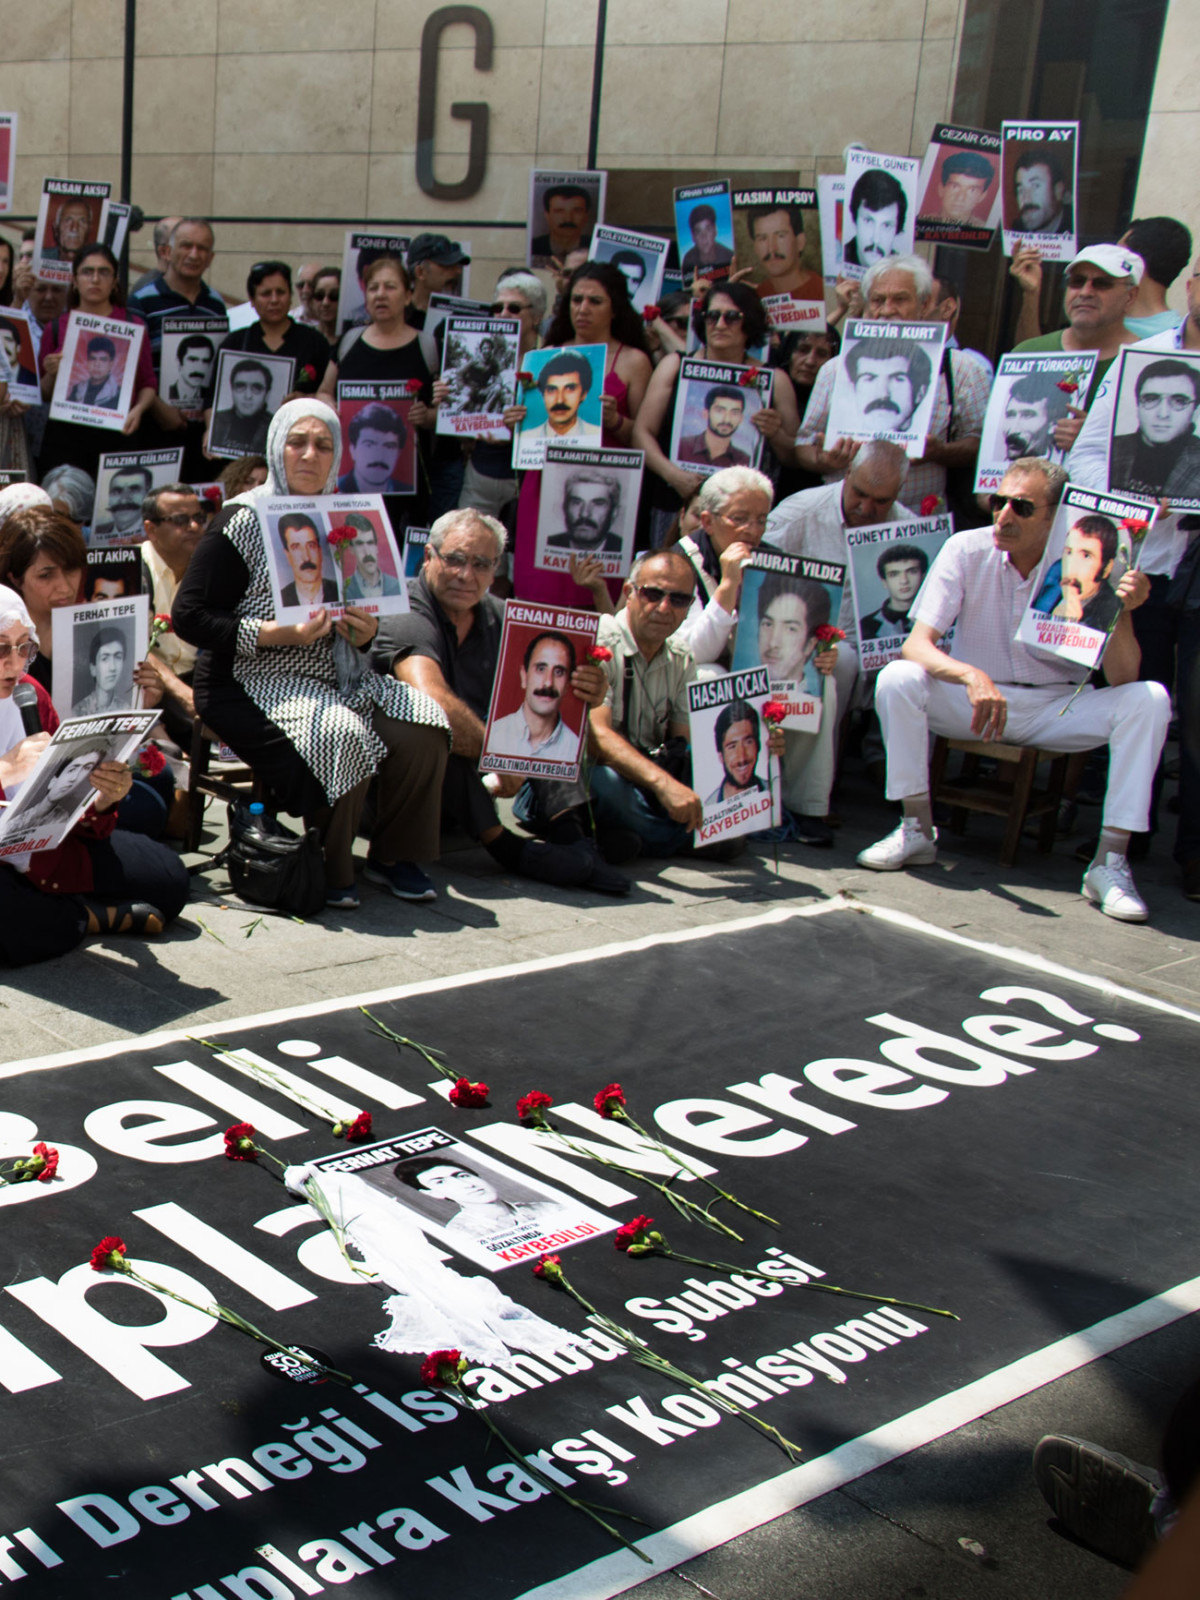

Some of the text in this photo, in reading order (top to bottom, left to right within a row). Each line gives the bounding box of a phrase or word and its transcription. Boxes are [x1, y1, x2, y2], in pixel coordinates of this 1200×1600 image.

[415, 5, 494, 201] G
[939, 128, 978, 145] CEZAİR
[1006, 128, 1073, 141] PİRO AY
[850, 152, 915, 172] VEYSEL GÜNEY
[47, 181, 109, 195] HASAN AKSU
[733, 190, 815, 205] KASIM ALPSOY
[356, 237, 387, 248] SONER
[599, 229, 638, 245] SÜLEYMAN
[75, 315, 136, 338] EDİP ÇELİK
[164, 320, 205, 332] SÜLEYMAN
[453, 320, 487, 331] MAKSUT
[853, 319, 937, 339] ÜZEYİR KURT
[684, 364, 731, 381] SERDAR
[1004, 359, 1035, 372] TALAT
[341, 383, 376, 398] İSMAİL
[873, 431, 918, 441] GÖZALTINDA
[105, 452, 177, 467] NAZIM GÜLMEZ
[548, 450, 641, 465] SELAHATTİN AKBULUT
[1068, 491, 1148, 521] CEMİL KIRBAYIR
[848, 518, 948, 546] CÜNEYT AYDINLAR
[105, 548, 136, 563] AKİPA
[752, 551, 842, 582] MURAT YILDIZ
[73, 603, 136, 622] FERHAT TEPE
[507, 606, 599, 632] KENAN BİLGİN
[1036, 621, 1081, 634] GÖZALTINDA
[861, 642, 877, 653] 28
[1037, 630, 1099, 649] KAYBEDİLDİ
[692, 671, 768, 709] HASAN OCAK
[58, 715, 150, 741] FERHAT TEPE
[482, 755, 577, 777] GÖZALTINDA KAYBEDİLDİ
[465, 985, 1141, 1208] Nerede?
[319, 1132, 451, 1174] FERHAT TEPE
[486, 1229, 543, 1252] GÖZALTINDA
[496, 1219, 601, 1262] KAYBEDİLDİ
[56, 1407, 383, 1549] Derneği
[624, 1246, 827, 1342] Şubesi
[425, 1305, 929, 1523] Karşı Komisyonu
